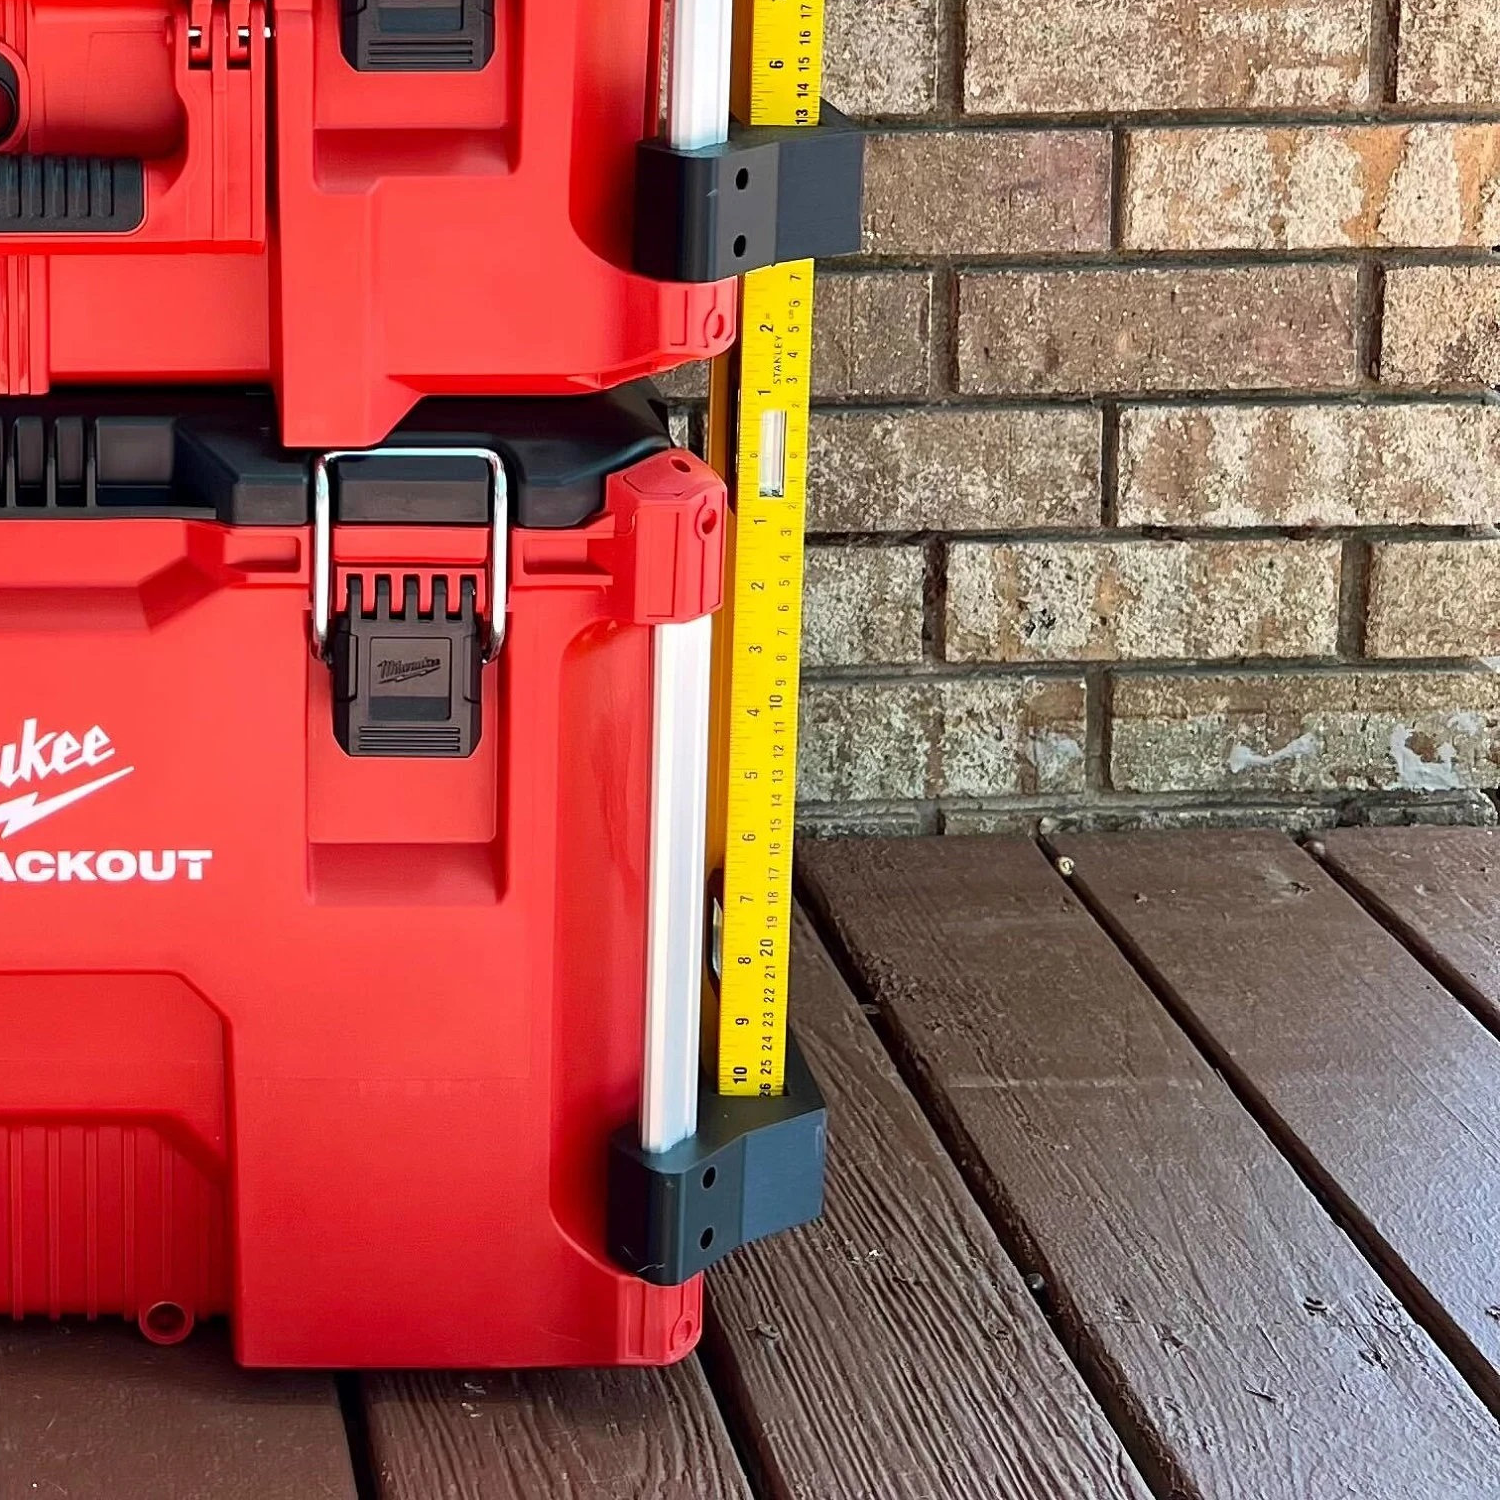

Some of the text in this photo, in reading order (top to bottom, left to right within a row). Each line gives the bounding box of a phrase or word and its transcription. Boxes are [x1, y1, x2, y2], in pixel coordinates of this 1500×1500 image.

[801, 4, 812, 18] 17
[799, 31, 810, 45] 16
[769, 60, 783, 69] 6
[798, 57, 810, 72] 15
[796, 83, 809, 98] 14
[795, 109, 808, 124] 13
[773, 335, 782, 384] STANLEY
[751, 582, 764, 590] 2
[378, 657, 440, 678] Milwaukee
[769, 695, 783, 710] 10
[747, 709, 760, 717] 4
[774, 721, 785, 734] 11
[773, 745, 784, 758] 12
[772, 770, 783, 783] 13
[771, 795, 782, 807] 14
[770, 819, 781, 832] 15
[769, 843, 780, 856] 16
[768, 867, 780, 881] 17
[768, 892, 778, 904] 18
[767, 916, 777, 928] 19
[760, 939, 773, 956] 20
[764, 965, 775, 979] 21
[764, 988, 774, 1003] 22
[763, 1012, 773, 1026] 23
[762, 1036, 772, 1051] 24
[760, 1060, 772, 1075] 25
[733, 1067, 747, 1084] 10
[760, 1084, 771, 1097] 26
